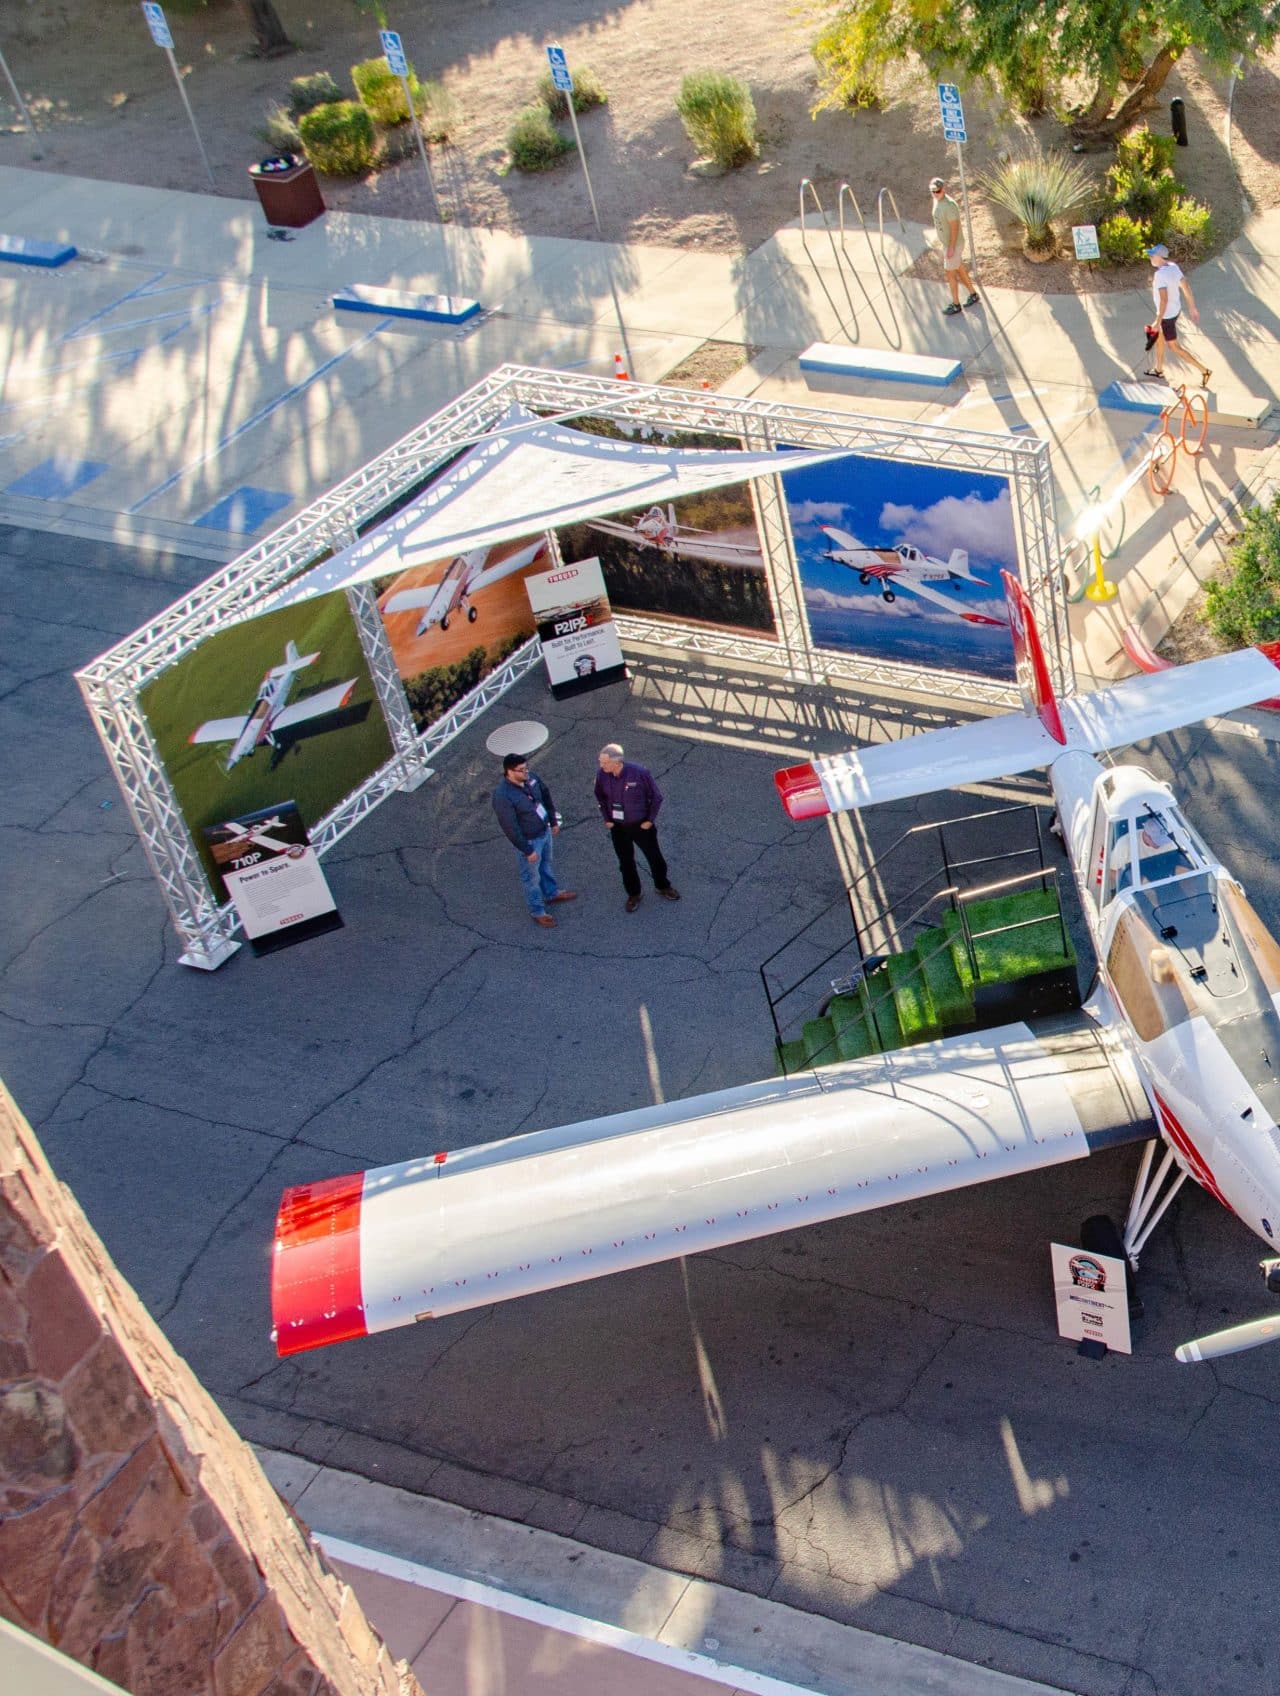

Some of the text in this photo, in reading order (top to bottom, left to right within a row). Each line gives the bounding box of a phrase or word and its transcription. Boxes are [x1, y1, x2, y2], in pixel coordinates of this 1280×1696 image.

[549, 570, 578, 583] THRUSH
[231, 852, 262, 869] 710P
[239, 872, 260, 883] Power
